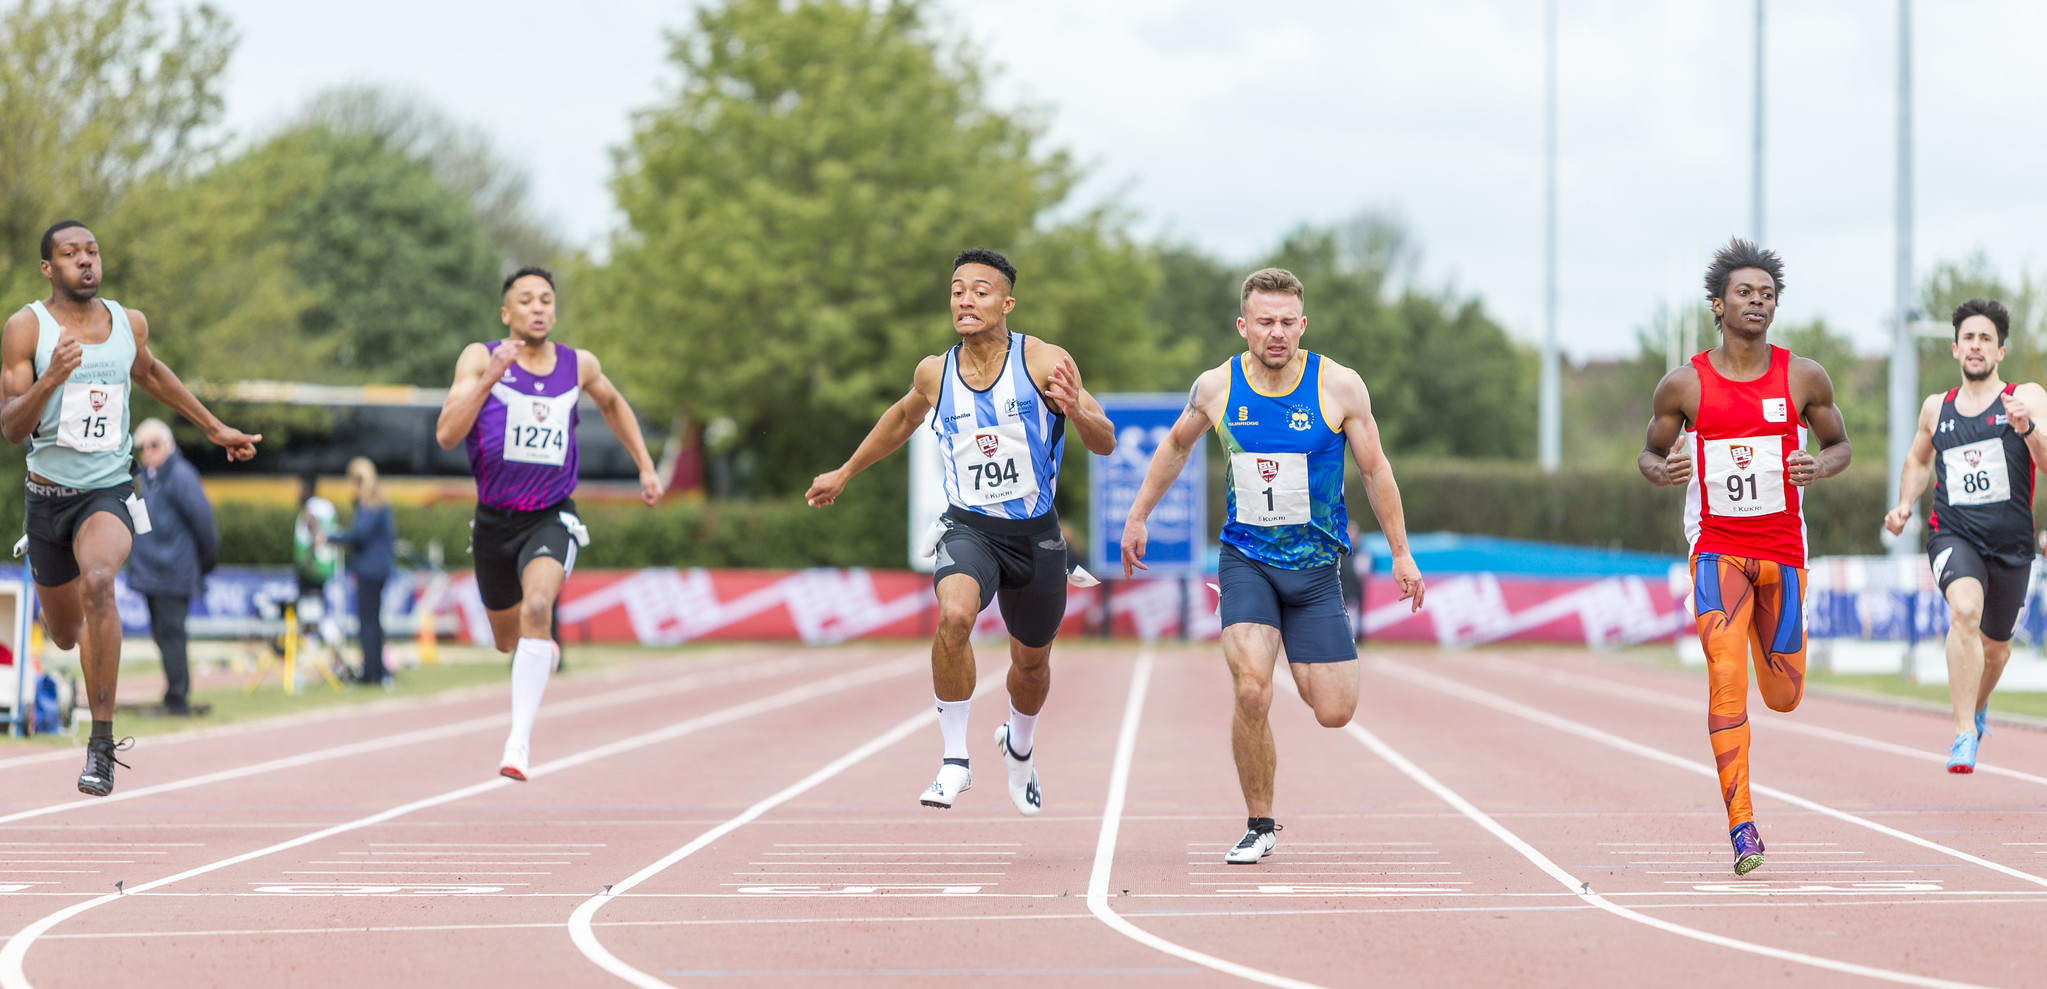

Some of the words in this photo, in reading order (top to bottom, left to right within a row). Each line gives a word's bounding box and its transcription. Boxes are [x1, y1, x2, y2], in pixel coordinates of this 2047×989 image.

[82, 416, 107, 438] 15
[512, 425, 563, 450] 1274
[968, 457, 1019, 490] 794
[1963, 470, 1990, 494] 86
[990, 490, 1013, 499] KUKRI
[1262, 487, 1274, 511] 1
[1726, 473, 1758, 501] 91
